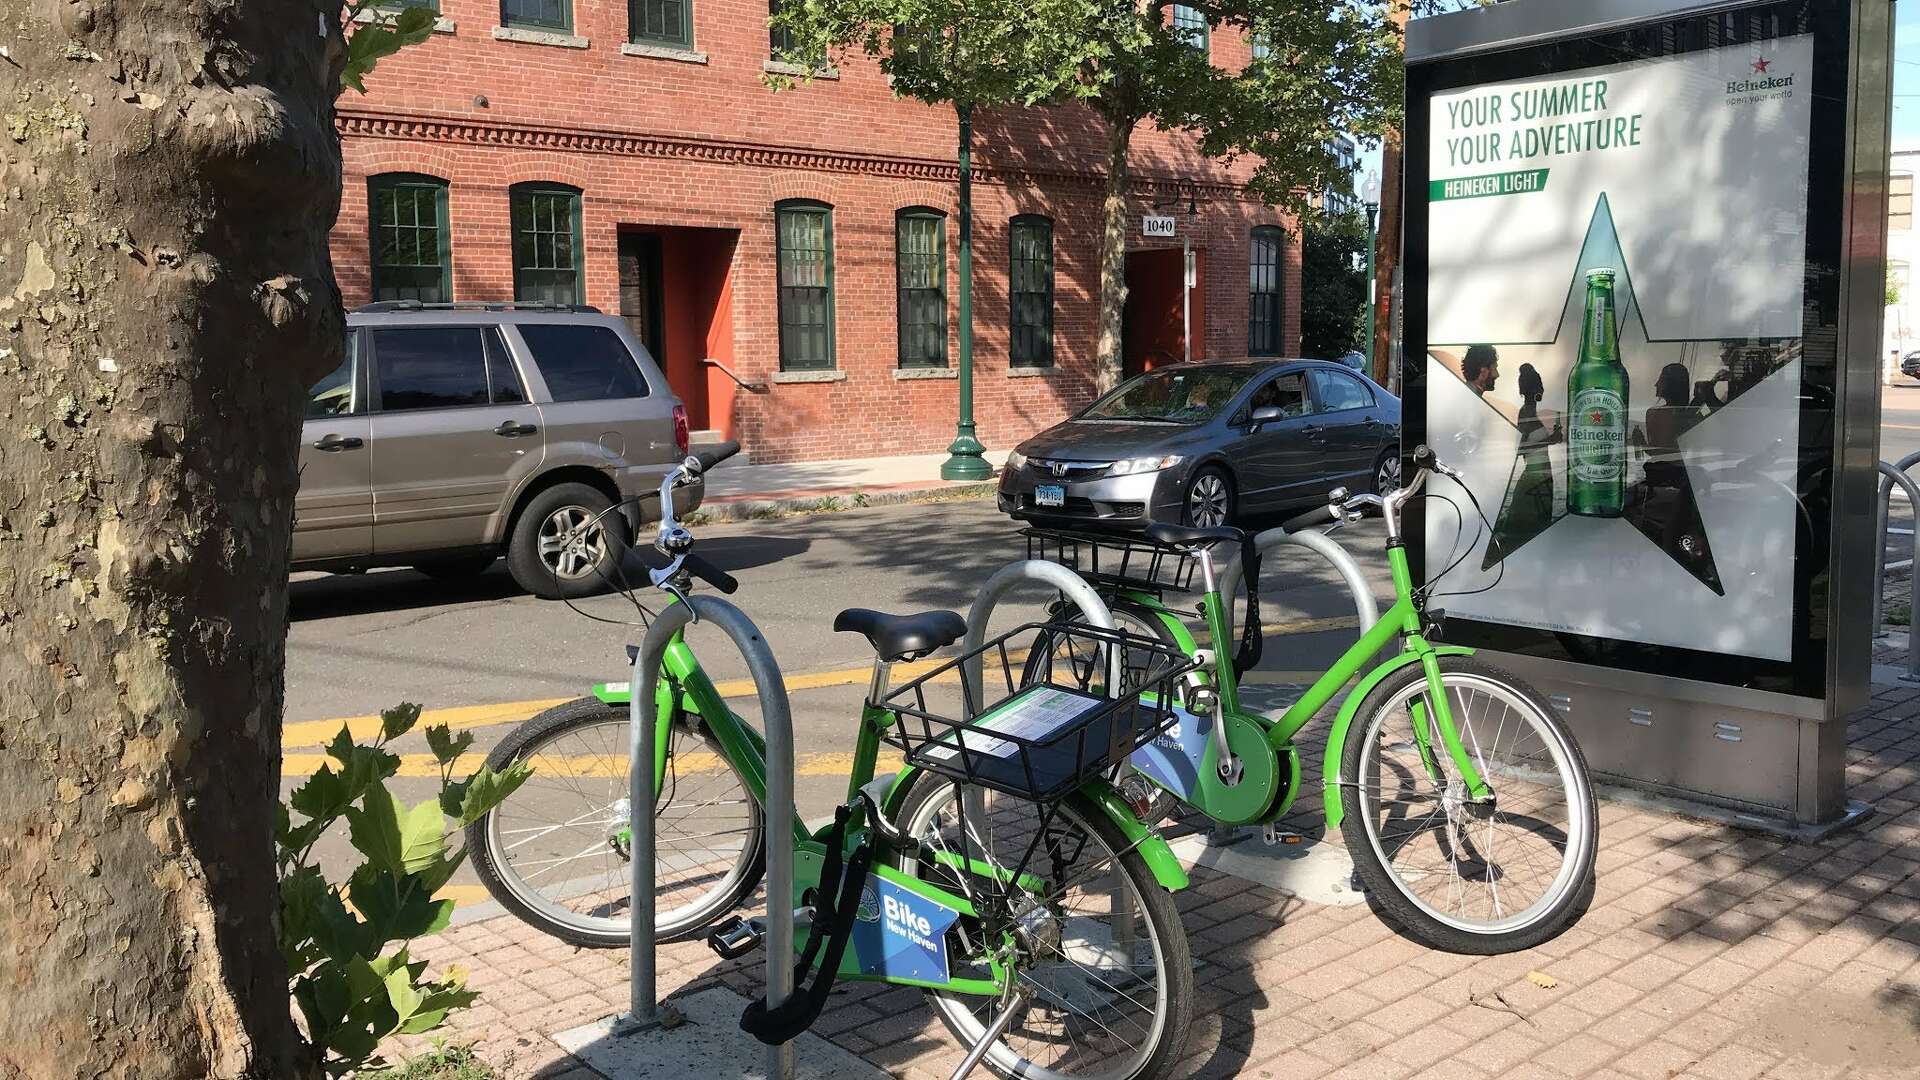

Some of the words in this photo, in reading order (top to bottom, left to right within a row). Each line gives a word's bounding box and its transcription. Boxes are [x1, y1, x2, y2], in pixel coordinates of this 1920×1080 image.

[1726, 75, 1793, 94] Heineken
[1447, 95, 1502, 130] YOUR
[1511, 80, 1608, 122] SUMMER
[1749, 95, 1768, 105] your
[1447, 132, 1501, 167] YOUR
[1508, 114, 1643, 160] ADVENTURE
[1444, 176, 1500, 199] HEINEKEN
[1504, 172, 1540, 193] LIGHT
[1147, 220, 1173, 233] 1040
[1570, 428, 1623, 442] Heineken
[1157, 735, 1185, 752] Haven
[884, 894, 932, 937] Bike
[886, 918, 907, 937] New
[907, 929, 938, 953] Haven
